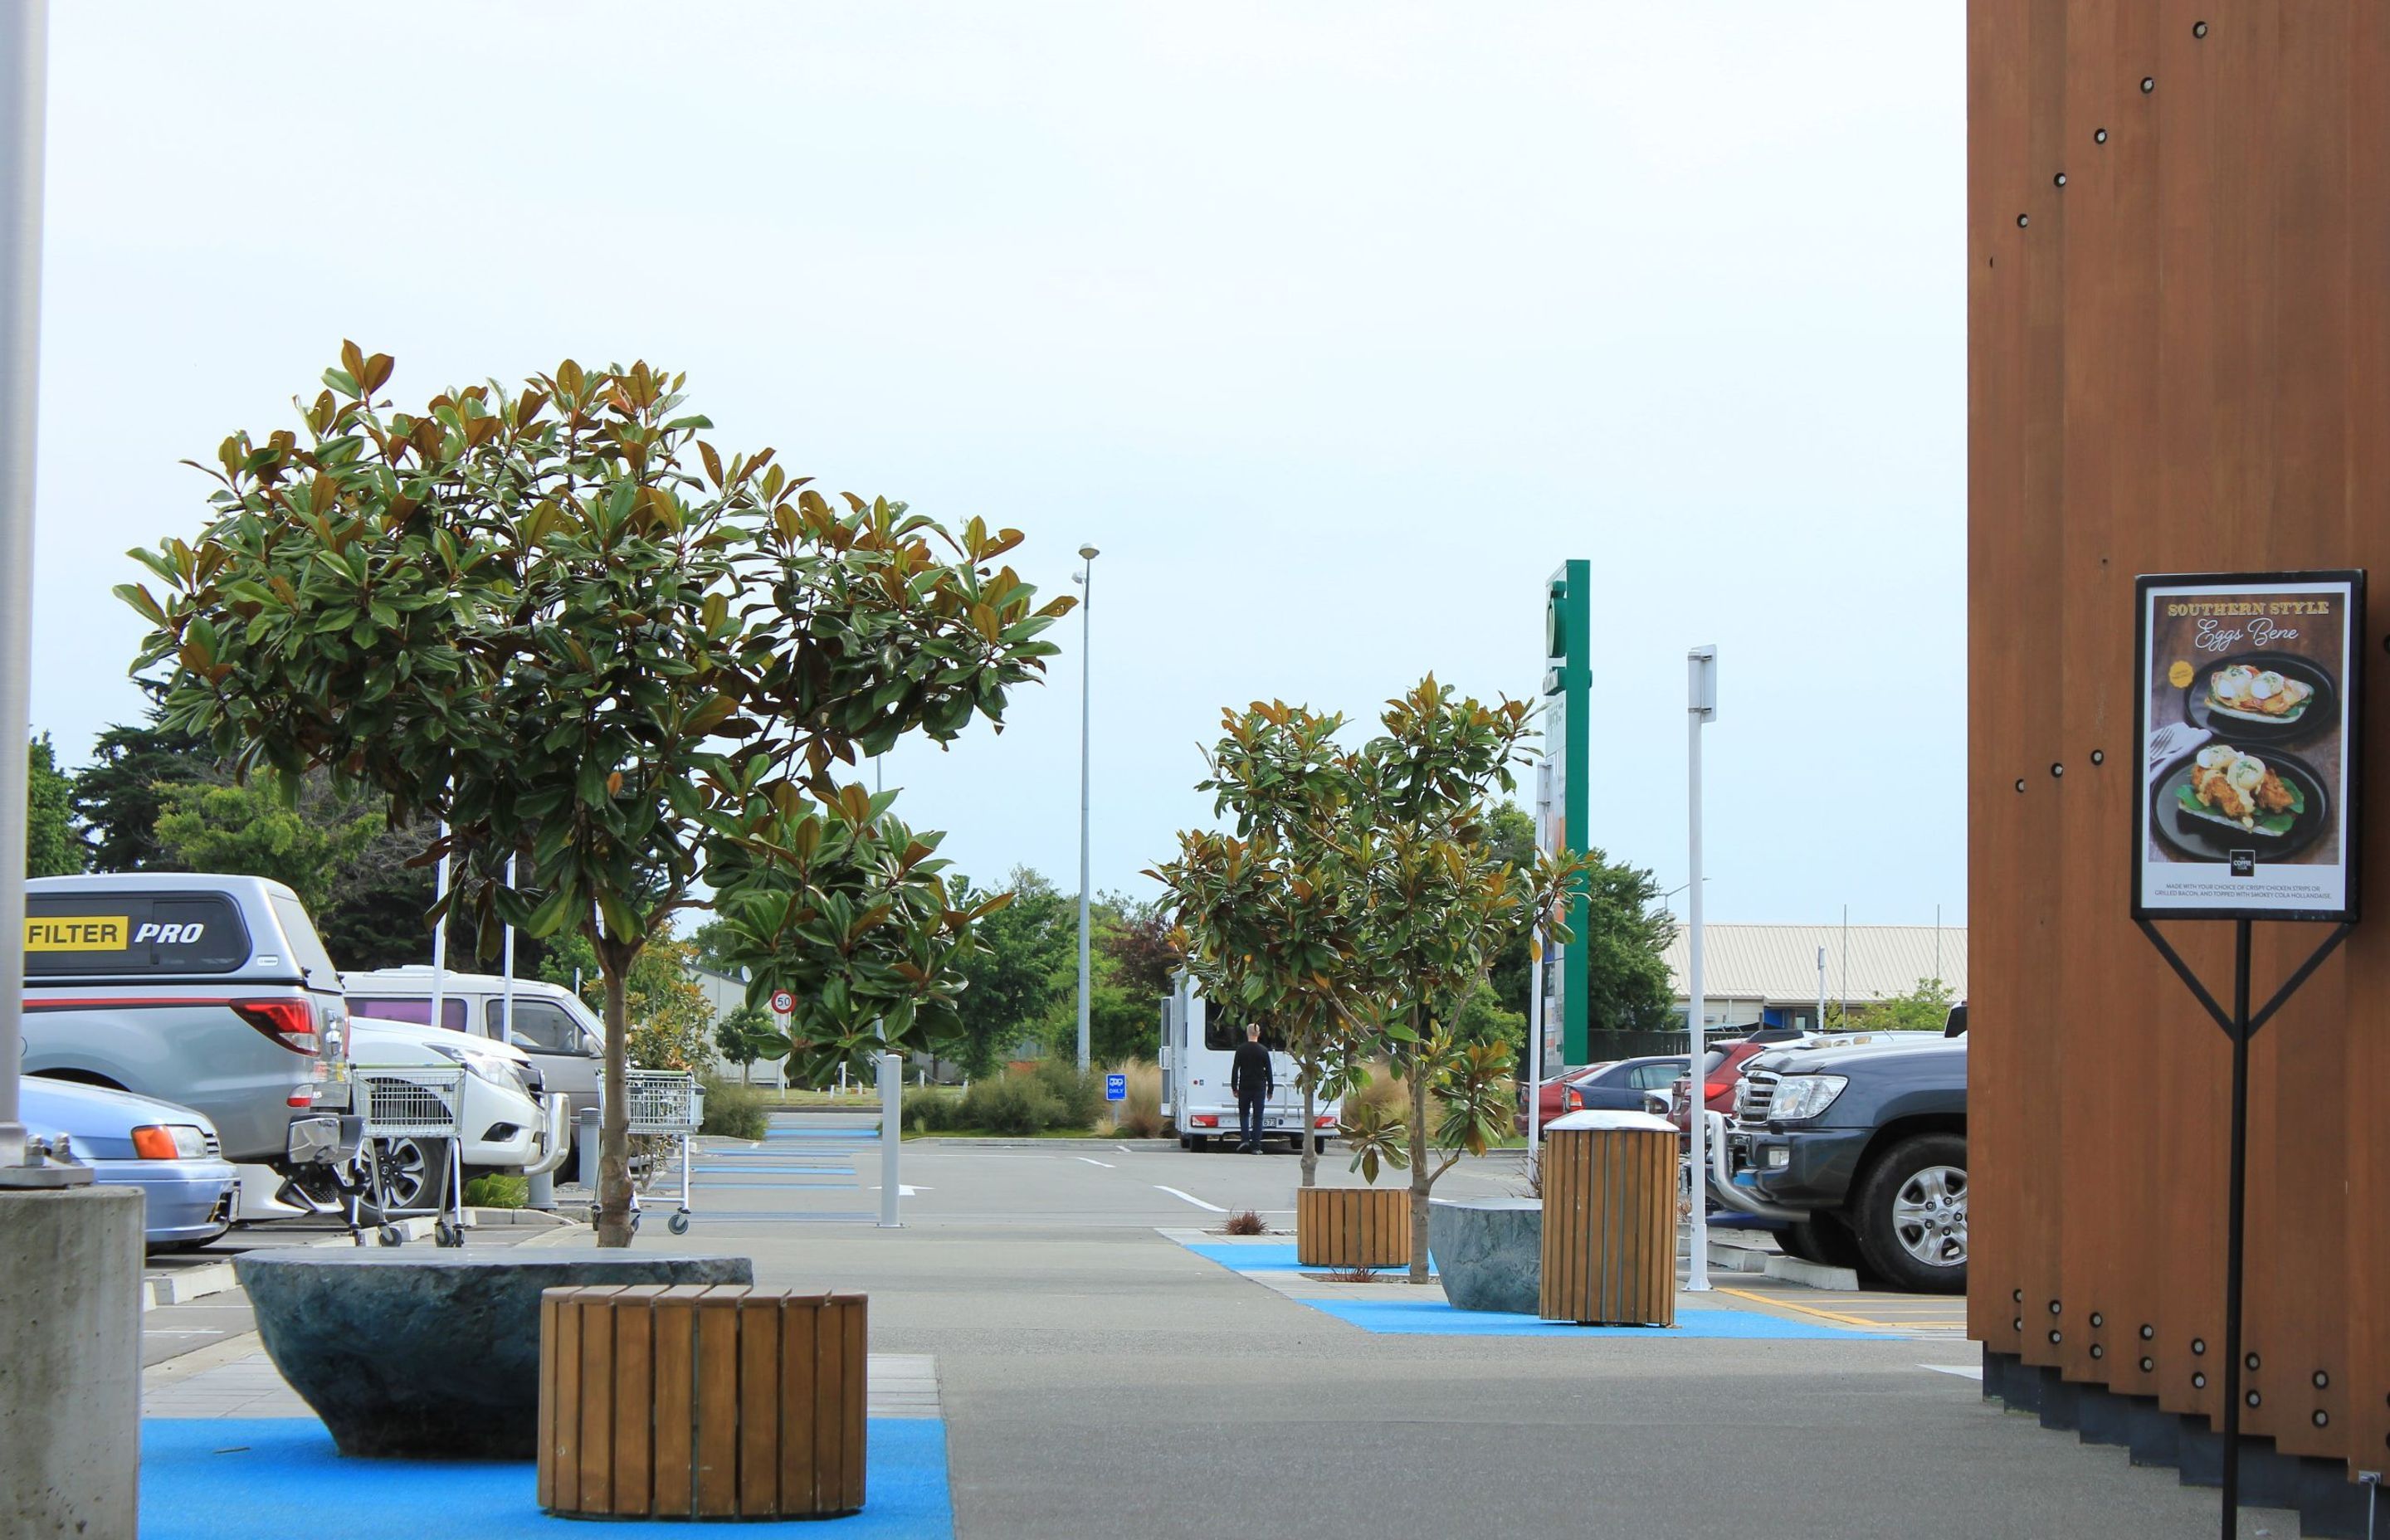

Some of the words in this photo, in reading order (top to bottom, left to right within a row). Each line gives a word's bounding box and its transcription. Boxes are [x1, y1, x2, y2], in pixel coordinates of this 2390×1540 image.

[2168, 602, 2266, 616] SOUTHERN
[2270, 602, 2329, 616] STYLE
[2195, 618, 2244, 652] Eggs
[2247, 617, 2299, 646] Bene
[28, 924, 118, 943] FILTER
[134, 923, 204, 943] PRO
[778, 997, 790, 1006] 50
